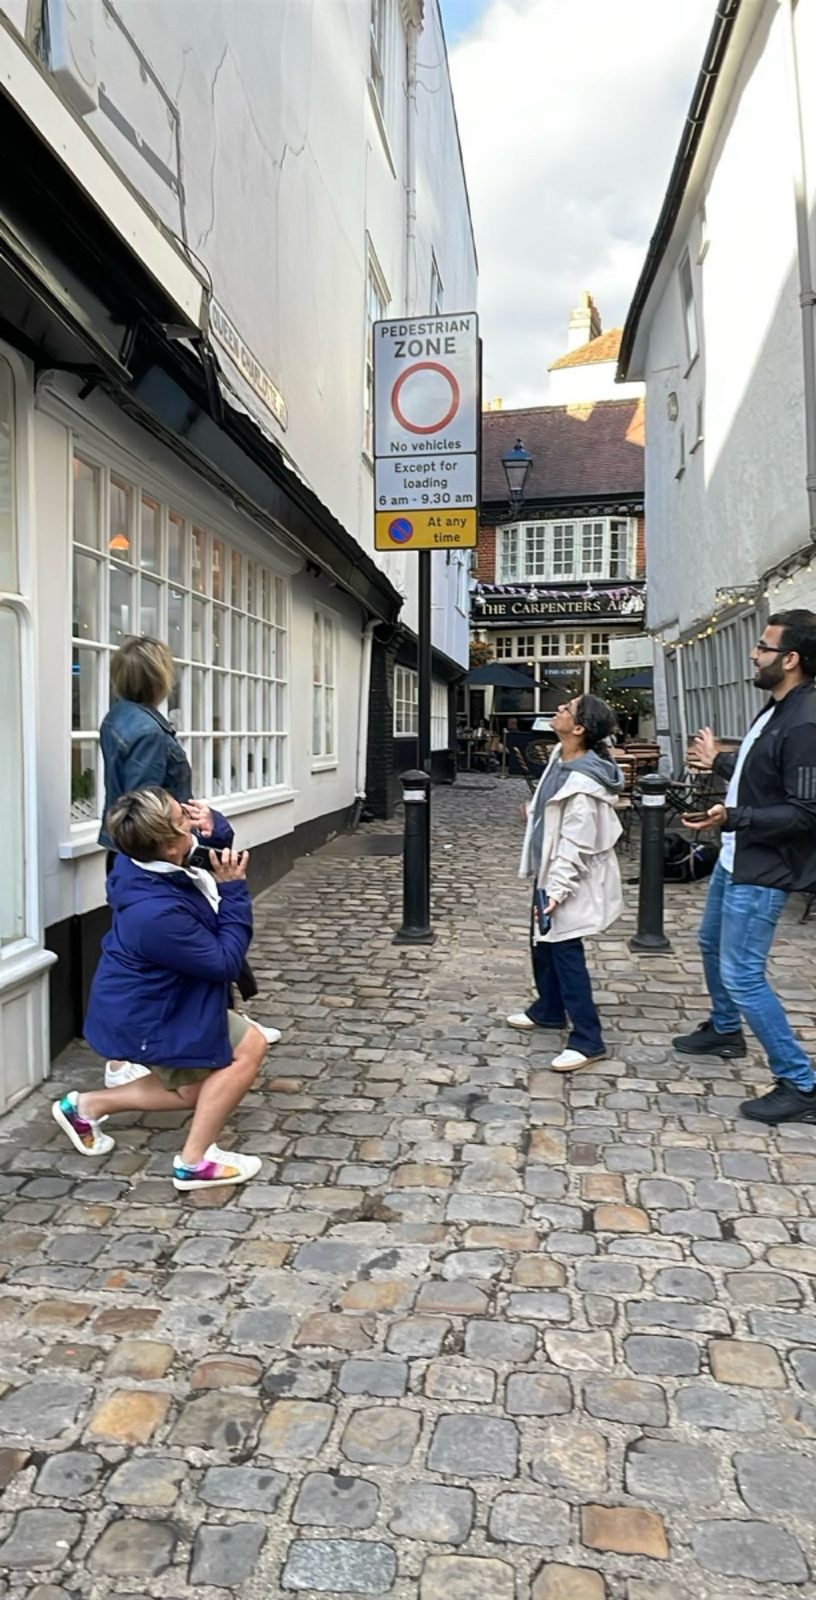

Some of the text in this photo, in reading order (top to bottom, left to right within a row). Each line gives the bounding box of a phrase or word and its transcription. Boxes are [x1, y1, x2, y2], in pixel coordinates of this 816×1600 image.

[381, 319, 470, 338] PEDESTRIAN
[394, 336, 456, 358] ZONE
[390, 438, 461, 452] No vehicles
[394, 460, 458, 473] Except for
[403, 477, 448, 489] loading
[379, 495, 387, 506] 6
[391, 496, 409, 505] am
[421, 493, 451, 504] 9.30
[455, 493, 473, 503] am
[427, 517, 468, 528] At any
[433, 532, 461, 543] time
[481, 602, 506, 615] THE
[511, 600, 601, 615] CARPENTERS
